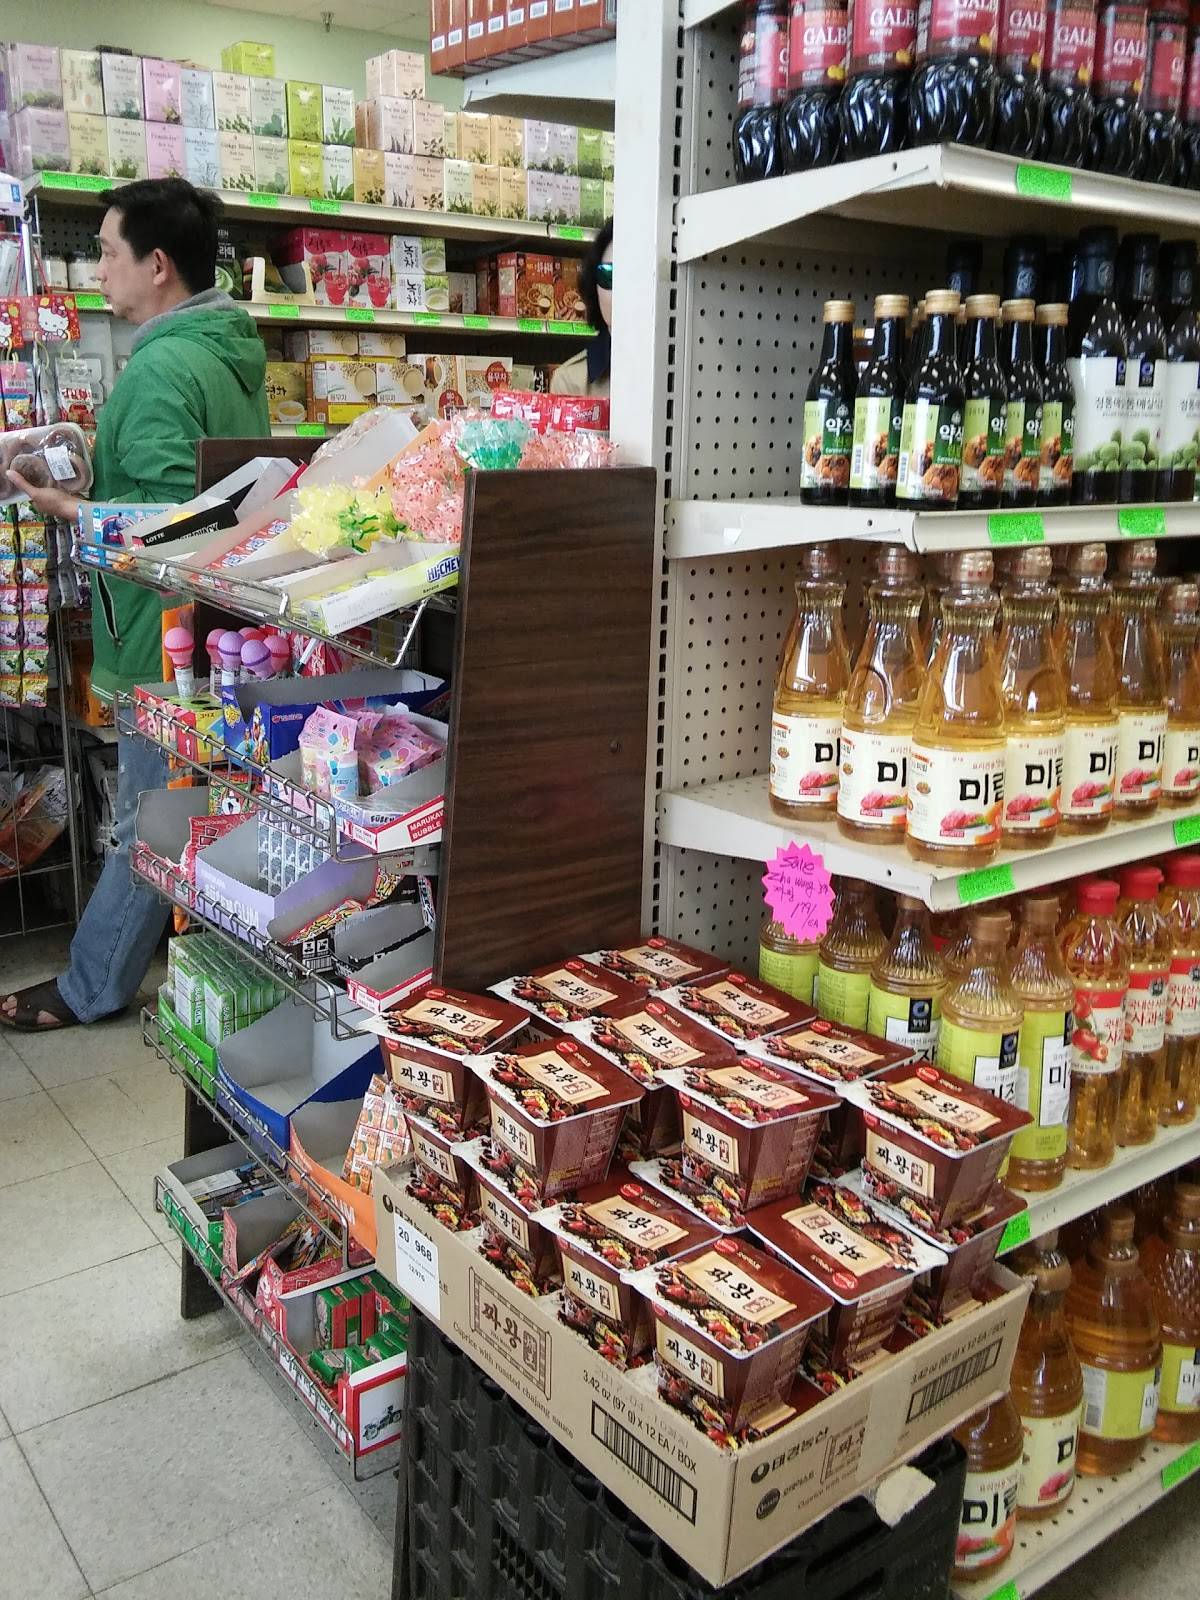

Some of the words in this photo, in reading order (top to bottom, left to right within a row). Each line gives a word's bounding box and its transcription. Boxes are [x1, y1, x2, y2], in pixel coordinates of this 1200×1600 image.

[145, 532, 165, 544] LOTTE
[1089, 745, 1118, 776] 미
[1139, 734, 1166, 763] 미
[412, 821, 441, 839] BUBBLE
[780, 856, 814, 875] Sale
[719, 989, 757, 1011] 짜왕
[425, 1006, 467, 1025] 짜왕
[634, 1022, 674, 1049] 짜왕
[400, 1066, 431, 1087] 짜왕
[540, 1063, 578, 1083] 짜왕
[914, 1088, 960, 1114] 짜왕
[497, 1114, 519, 1144] 짜왕
[691, 1126, 718, 1153] 짜왕
[418, 1142, 440, 1165] 짜왕
[877, 1146, 909, 1175] 짜왕
[487, 1199, 511, 1228] 짜왕
[608, 1208, 652, 1230] 짜왕
[398, 1226, 410, 1243] 20
[415, 1240, 433, 1262] 968
[819, 1228, 868, 1262] 짜왕
[571, 1270, 599, 1299] 짜왕
[705, 1267, 755, 1300] 짜왕
[481, 1302, 523, 1349] 짜왕
[453, 1321, 478, 1351] Caprice
[479, 1346, 494, 1366] with
[666, 1337, 699, 1371] 짜왕
[583, 1369, 600, 1393] 3.42
[612, 1395, 626, 1414] (97
[645, 1423, 656, 1439] 12
[657, 1433, 671, 1453] EA
[677, 1450, 697, 1475] BOX
